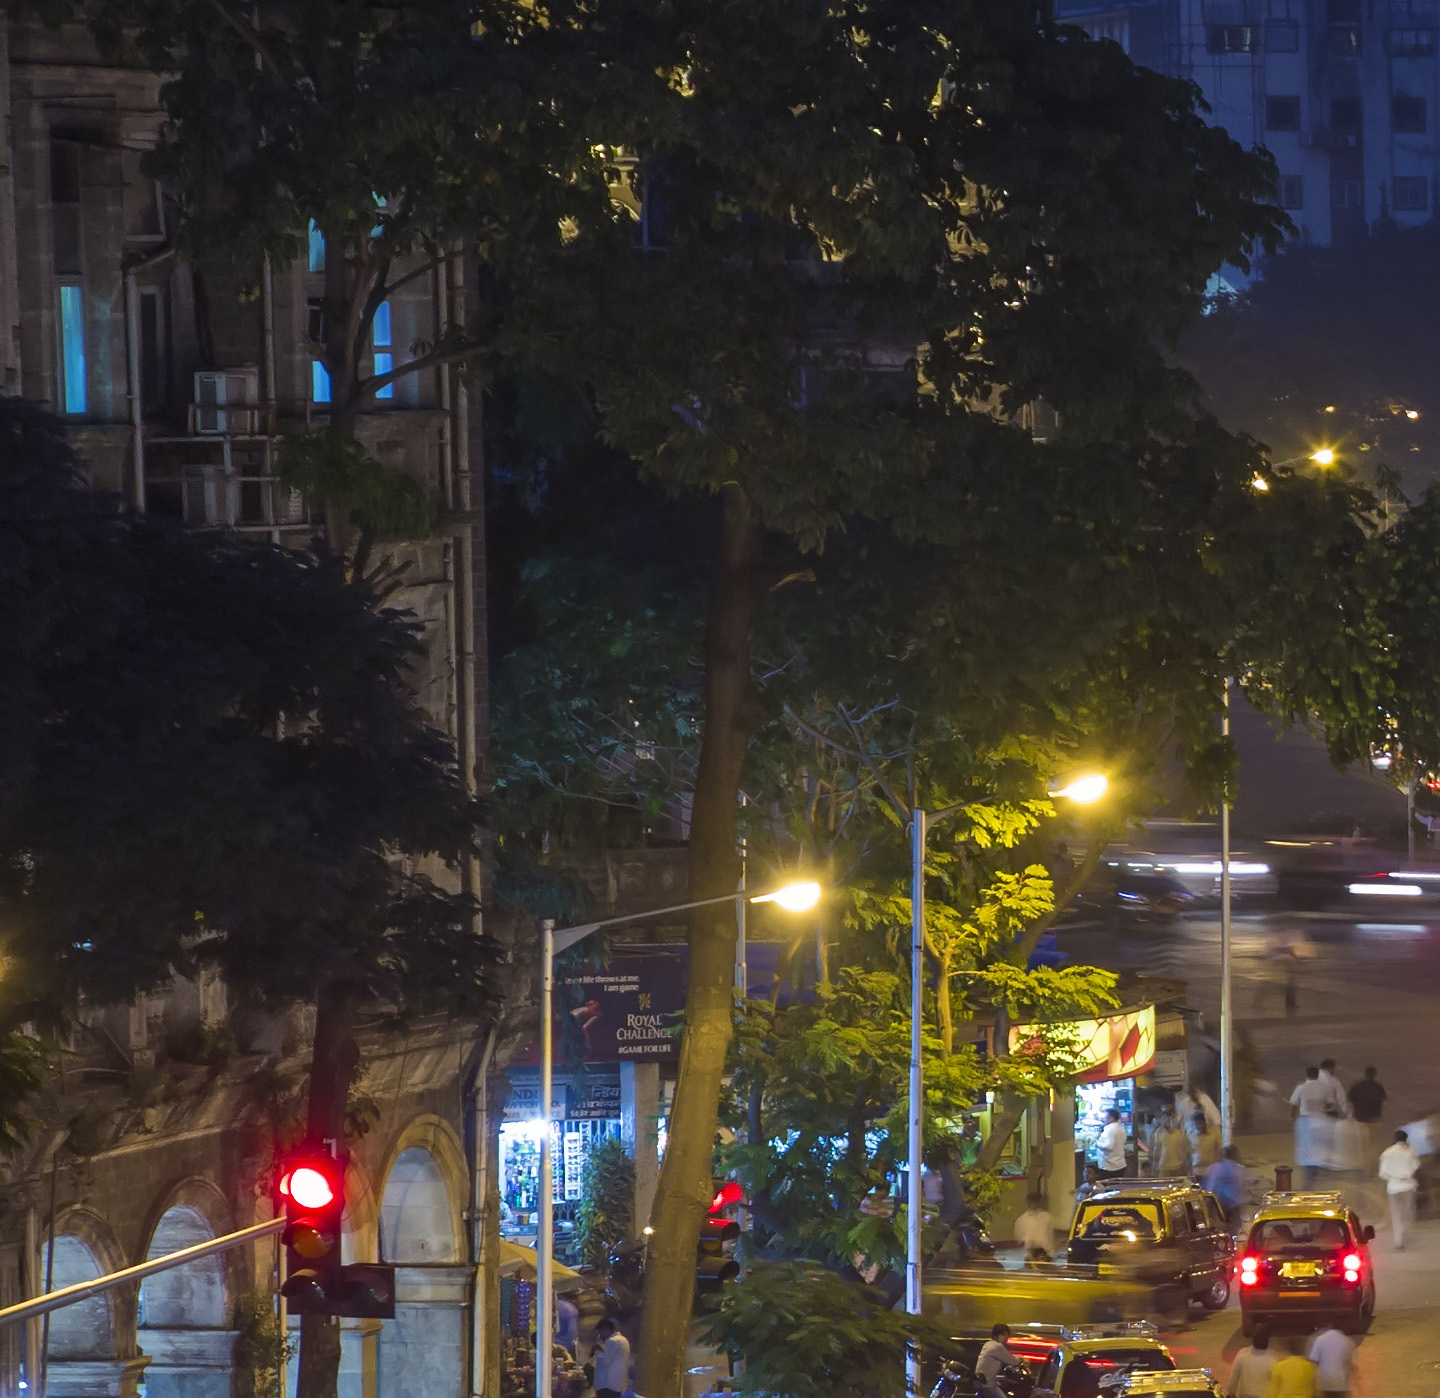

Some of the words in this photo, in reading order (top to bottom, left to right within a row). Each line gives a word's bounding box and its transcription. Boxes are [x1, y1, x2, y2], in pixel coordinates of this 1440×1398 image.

[627, 1013, 663, 1030] ROYAL
[643, 1044, 659, 1053] FOR
[658, 1044, 672, 1053] LIFE
